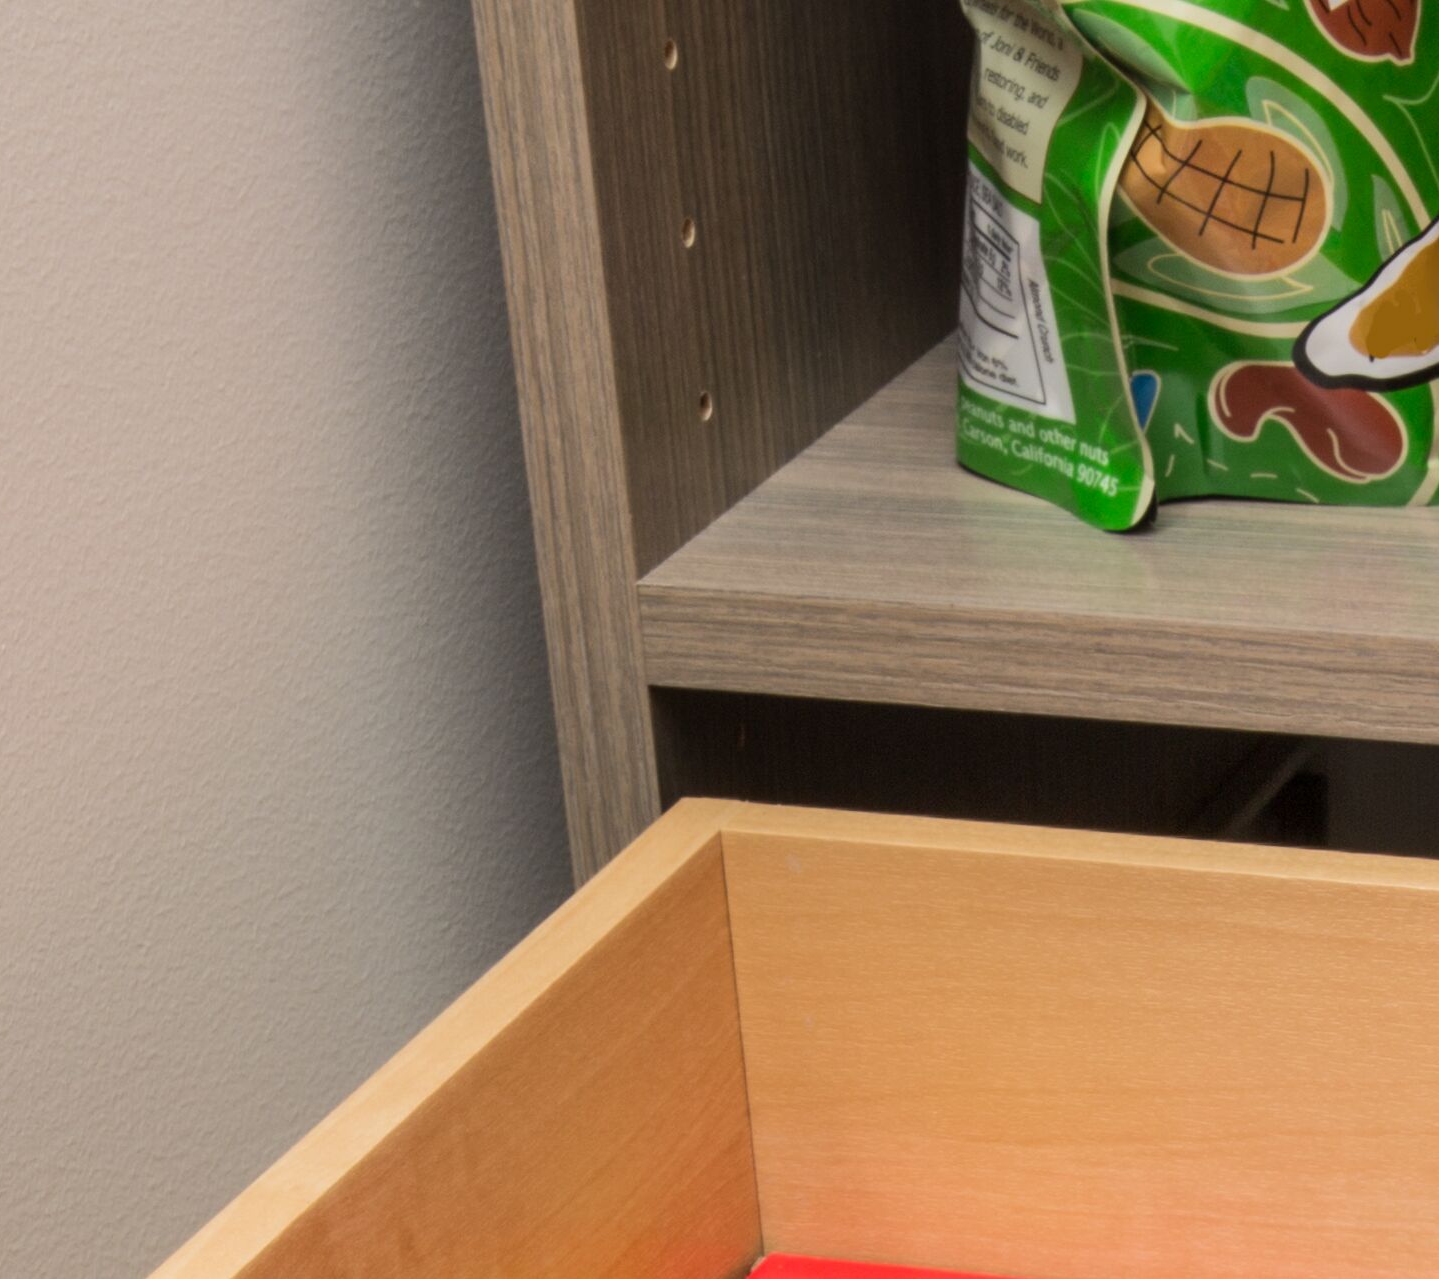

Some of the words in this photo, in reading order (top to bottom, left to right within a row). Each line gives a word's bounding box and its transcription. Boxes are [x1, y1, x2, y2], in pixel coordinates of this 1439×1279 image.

[963, 418, 1008, 457] Carson,
[1011, 433, 1073, 477] California
[1075, 457, 1118, 496] 90745
[1008, 413, 1034, 437] and
[1040, 420, 1076, 453] other
[1080, 437, 1108, 466] nuts
